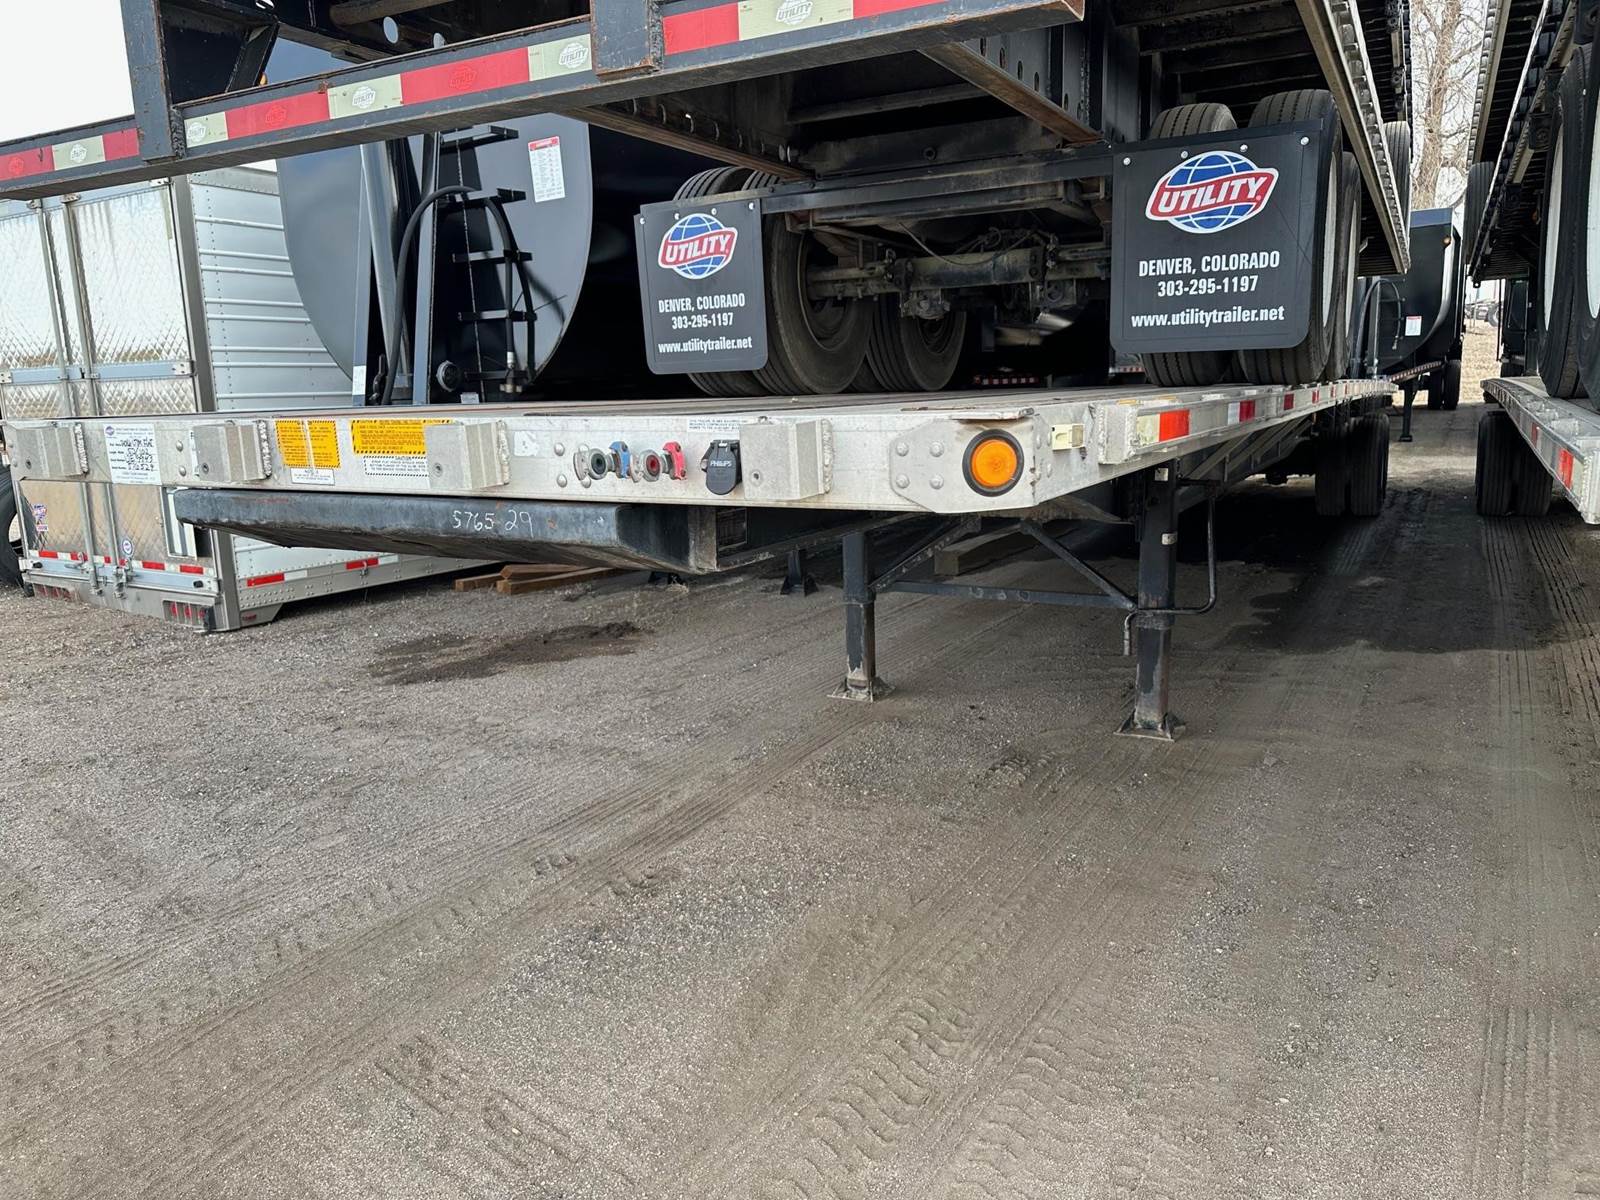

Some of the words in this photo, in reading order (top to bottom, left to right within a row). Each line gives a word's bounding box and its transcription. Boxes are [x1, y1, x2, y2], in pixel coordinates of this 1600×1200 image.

[777, 3, 812, 20] UTILITY
[560, 48, 588, 64] UTILITY
[1158, 177, 1267, 213] UTILITY
[666, 235, 731, 262] UTILITY
[1139, 257, 1197, 277] DENVER,
[1201, 251, 1280, 272] COLORADO
[1157, 275, 1259, 297] 303-295-1197
[658, 297, 695, 313] DENVER,
[696, 293, 746, 310] COLORADO
[671, 312, 734, 329] 303-295-1197
[1131, 305, 1285, 328] www.utilitytrailer.net
[658, 336, 753, 353] www.utilitytrailer.net
[452, 510, 495, 531] 5765
